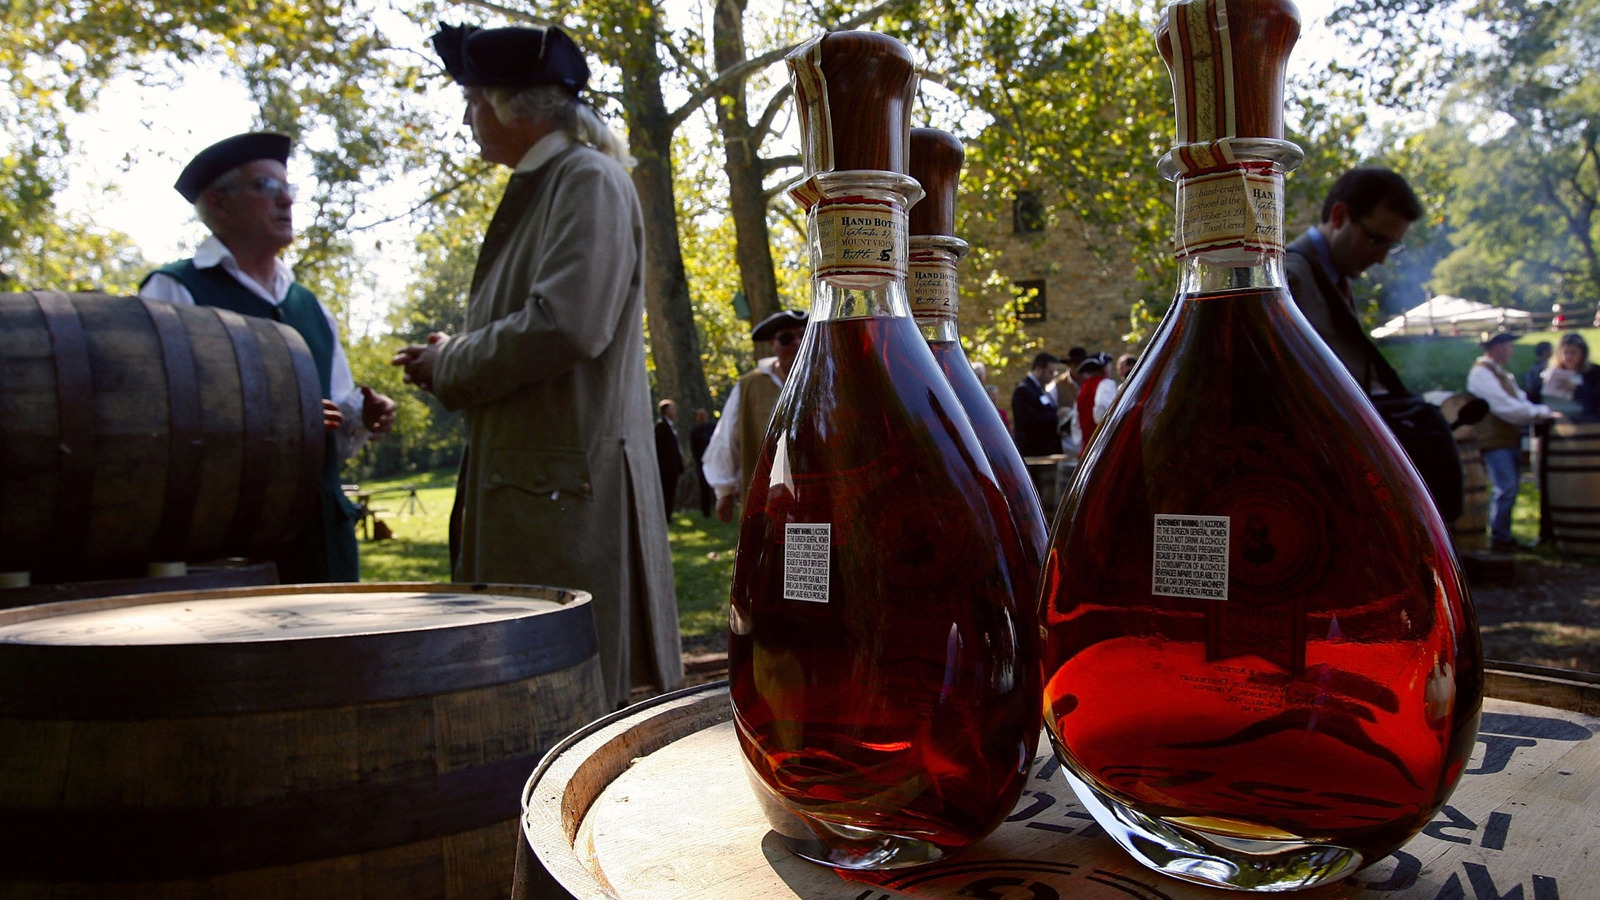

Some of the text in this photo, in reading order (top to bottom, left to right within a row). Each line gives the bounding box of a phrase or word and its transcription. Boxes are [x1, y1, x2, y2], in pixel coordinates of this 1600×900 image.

[842, 216, 872, 227] HAND
[841, 238, 871, 246] MOUNT
[943, 298, 950, 306] 2
[1198, 546, 1226, 554] PREGNANCY
[1162, 561, 1192, 569] CONSUMPTION
[1201, 589, 1224, 597] PROBLEMS.
